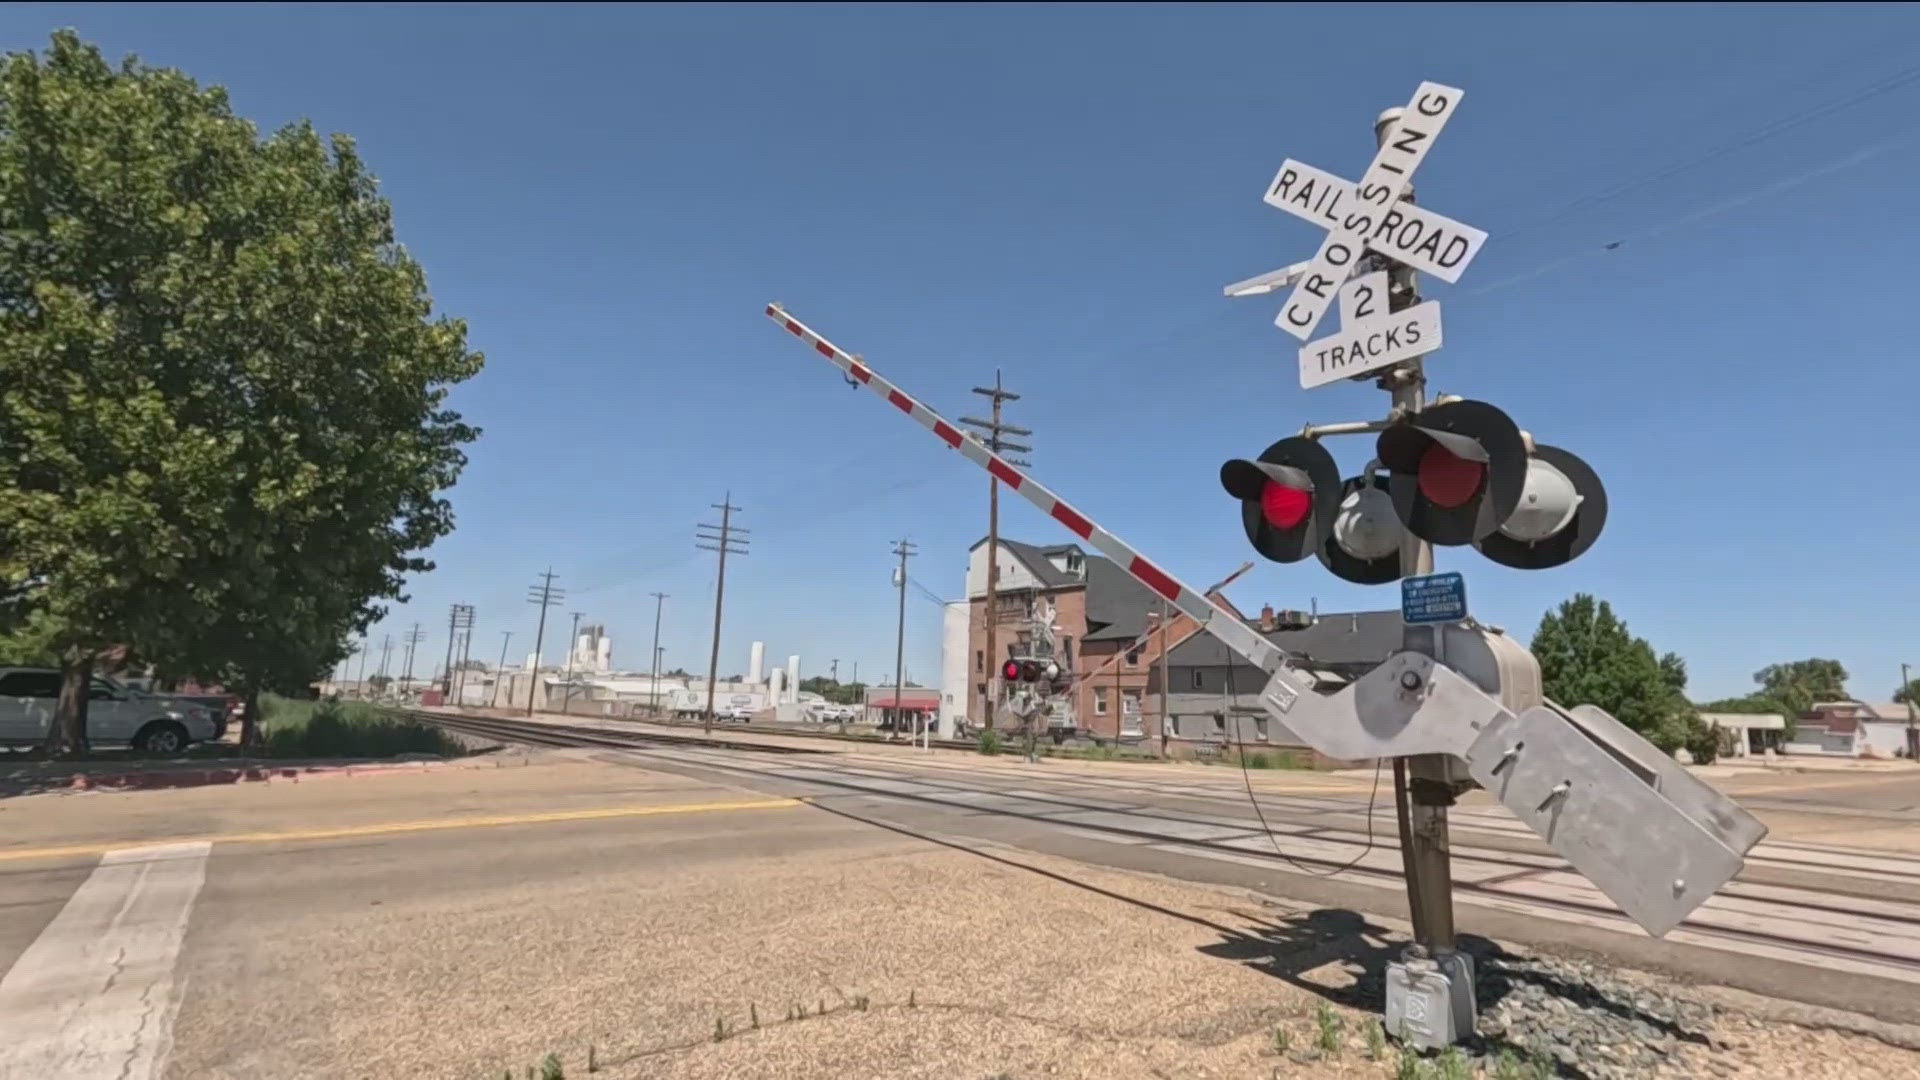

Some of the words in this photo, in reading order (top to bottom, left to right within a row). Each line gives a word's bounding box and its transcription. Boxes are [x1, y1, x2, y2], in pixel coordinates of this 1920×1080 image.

[1288, 92, 1447, 326] CROSSING
[1354, 287, 1374, 318] 2
[1317, 321, 1421, 372] TRACKS
